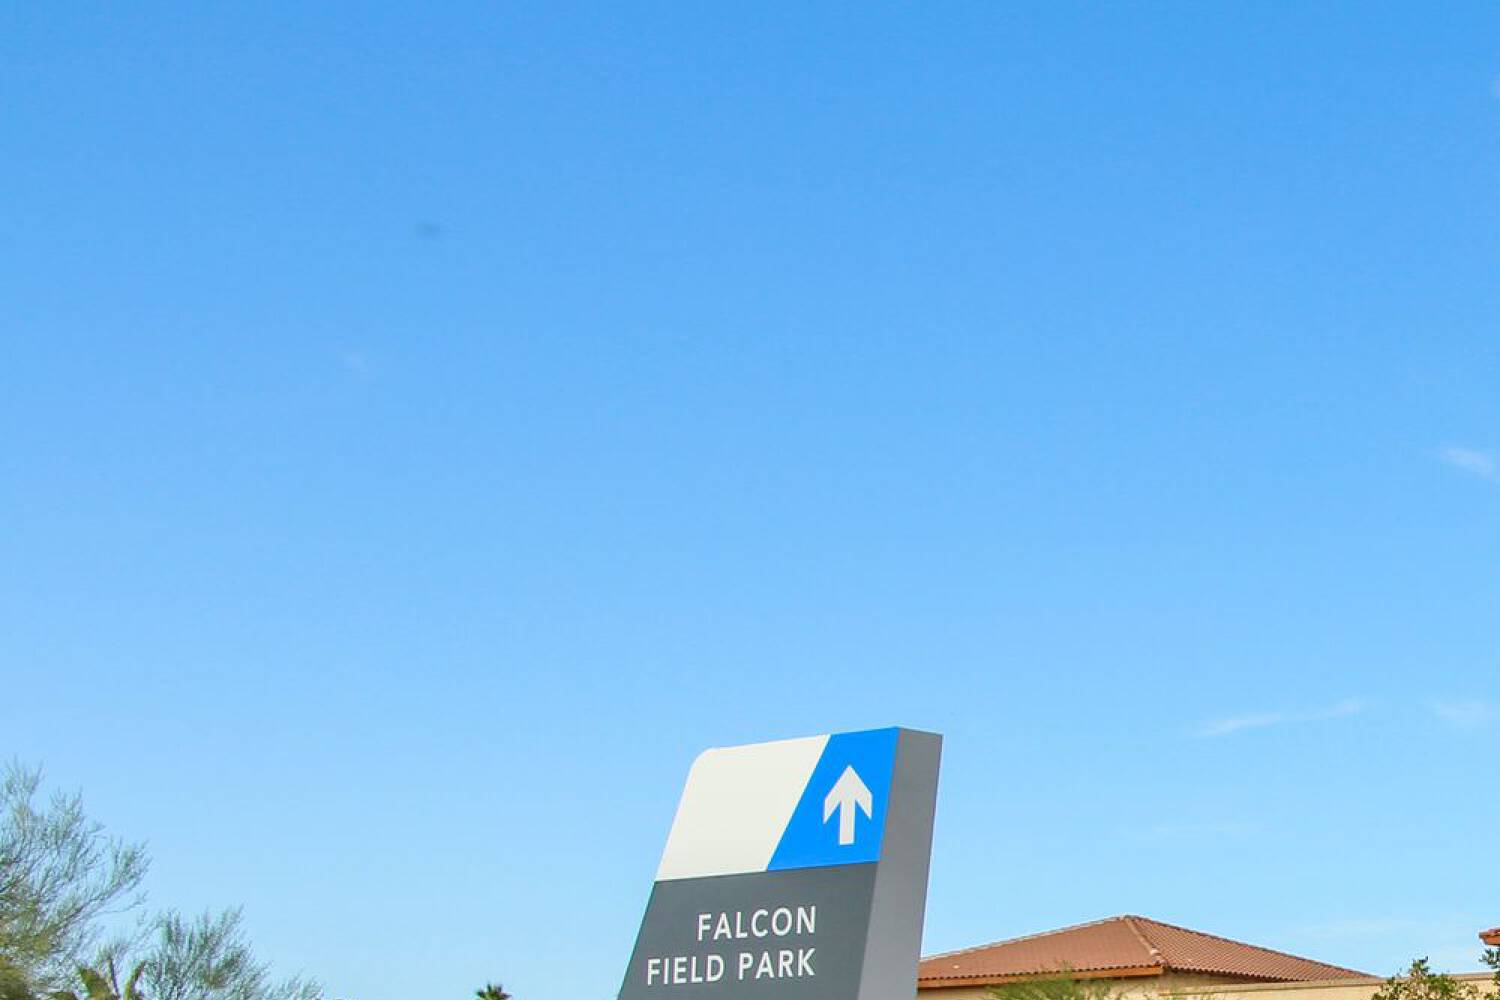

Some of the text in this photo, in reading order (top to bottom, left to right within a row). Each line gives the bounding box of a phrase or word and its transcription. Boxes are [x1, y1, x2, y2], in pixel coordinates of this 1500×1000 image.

[698, 906, 815, 941] FALCON
[648, 948, 815, 985] FIELD PARK
